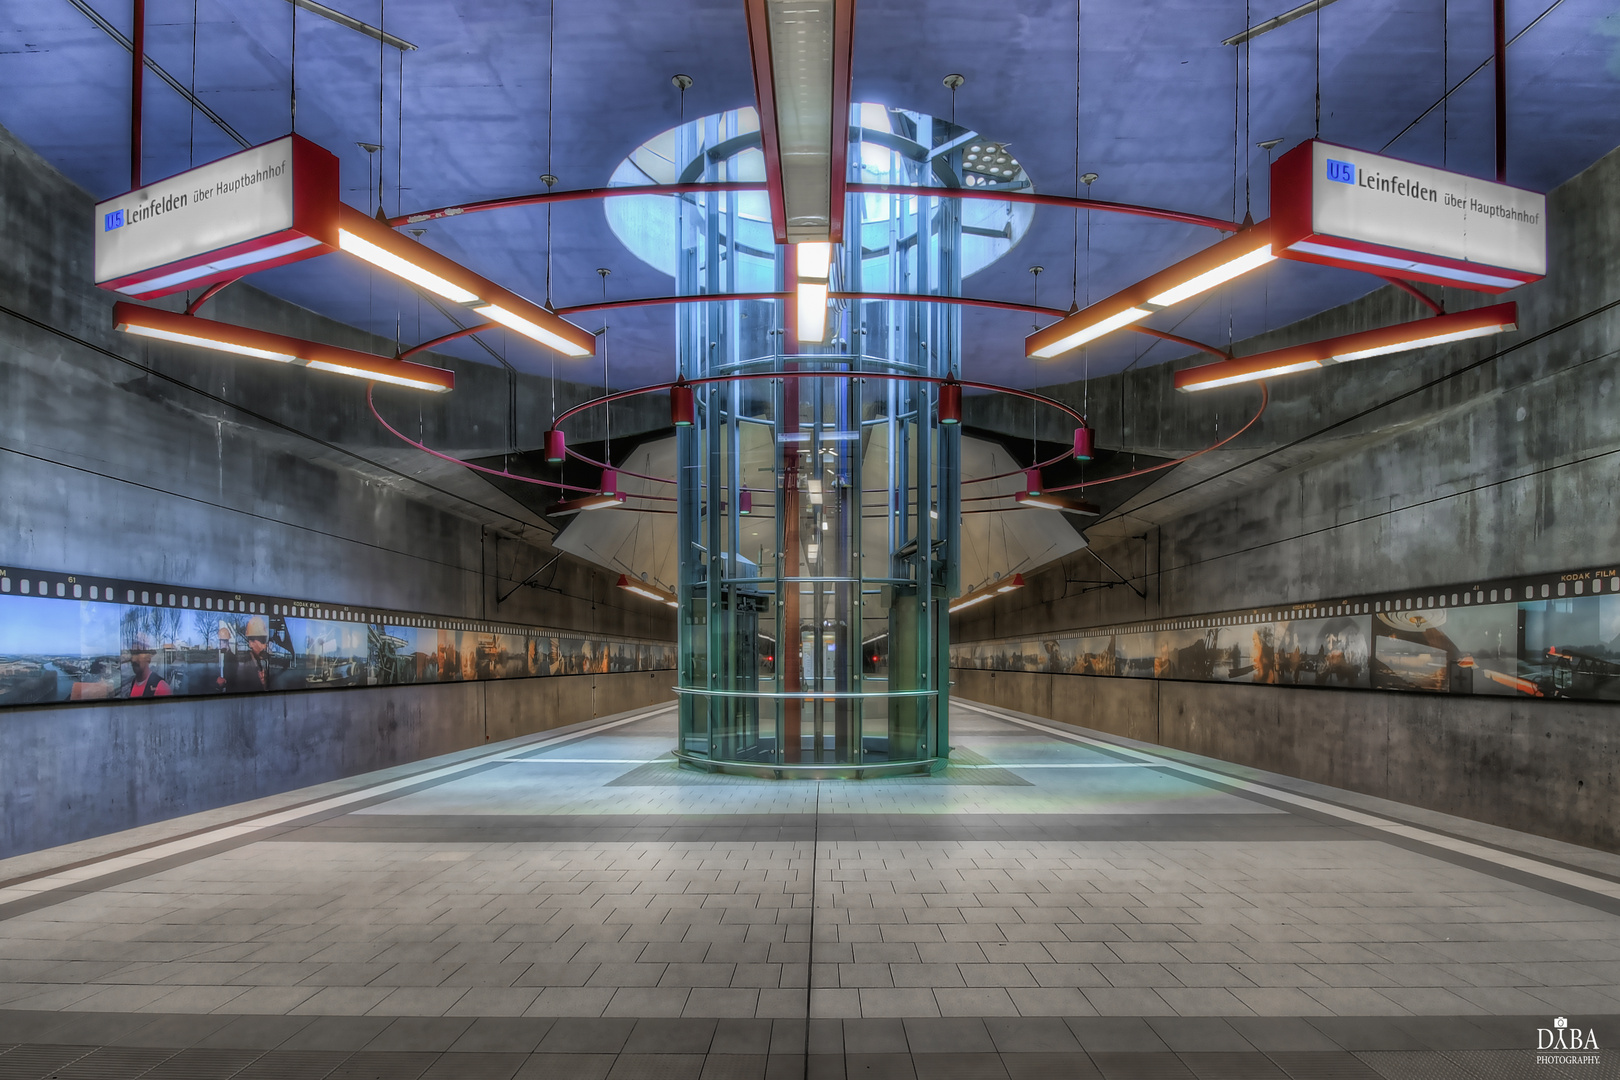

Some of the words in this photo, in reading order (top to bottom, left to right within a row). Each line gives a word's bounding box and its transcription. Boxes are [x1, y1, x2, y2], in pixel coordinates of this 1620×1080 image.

[106, 211, 122, 229] U5
[126, 192, 188, 225] Leinfelden
[193, 187, 214, 203] über
[216, 160, 286, 196] Hauptbahnhof
[1330, 162, 1351, 182] U5
[1358, 168, 1437, 203] Leinfelden
[1444, 192, 1467, 209] über
[1470, 198, 1540, 225] Hauptbahnhof
[1561, 572, 1590, 581] KODAK
[1595, 569, 1616, 578] FILM
